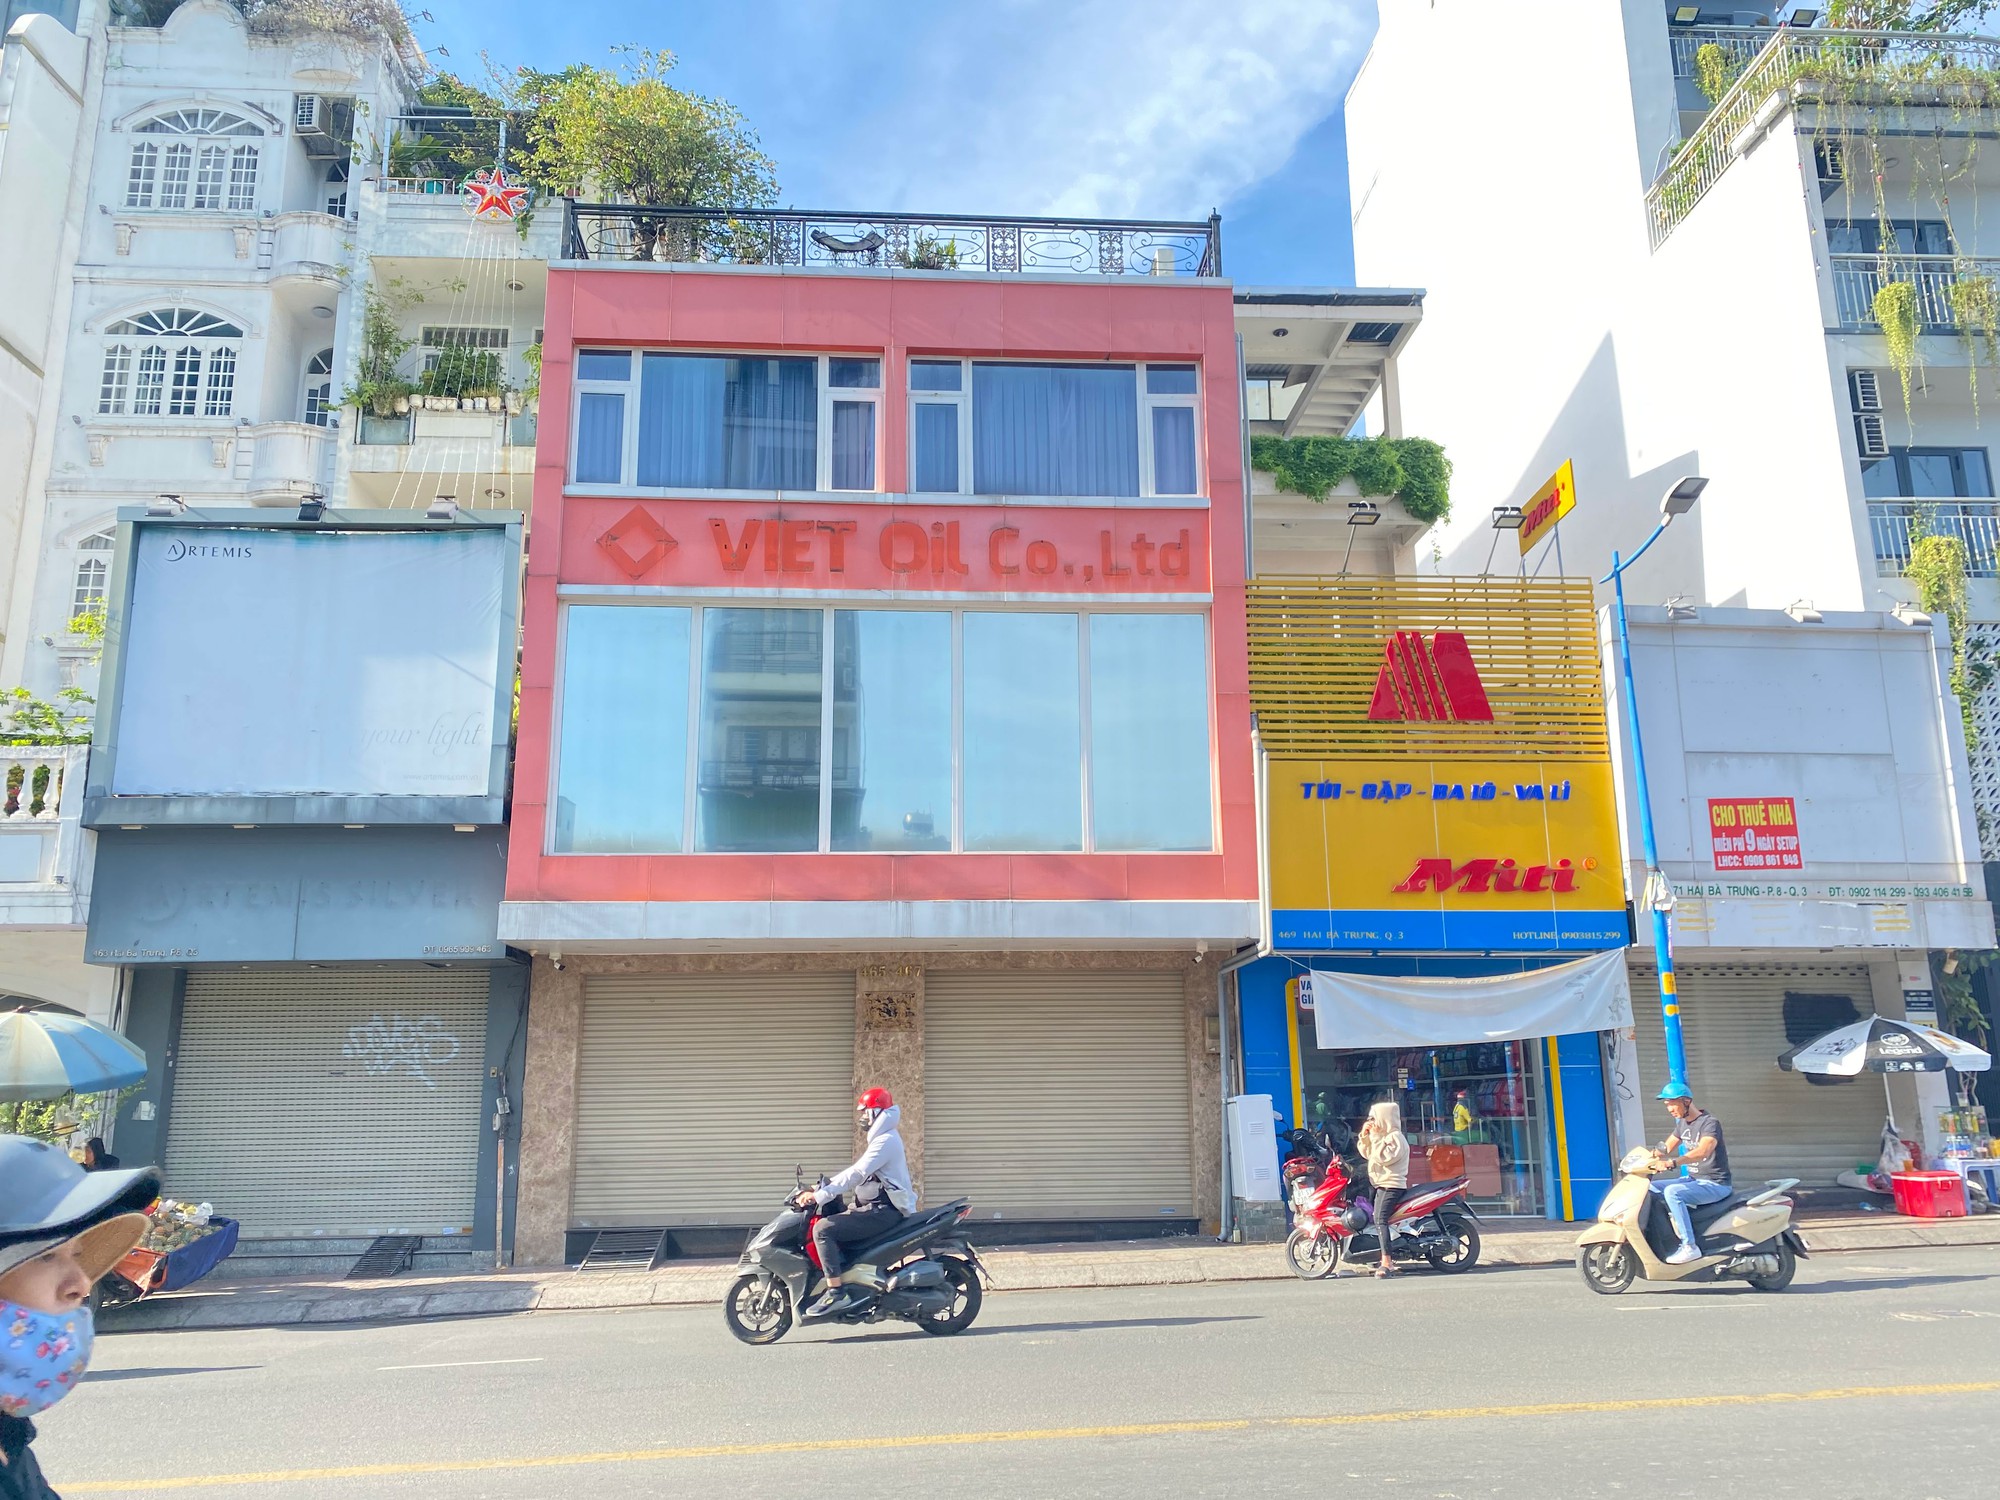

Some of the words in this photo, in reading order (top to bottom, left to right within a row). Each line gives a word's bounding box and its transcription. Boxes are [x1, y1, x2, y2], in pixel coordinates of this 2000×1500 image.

[164, 539, 252, 561] ARTEMIS
[708, 518, 858, 572] VIET
[879, 520, 968, 575] Oil
[427, 711, 485, 757] light
[1300, 779, 1341, 800] TÚI
[1432, 784, 1465, 800] BA
[1514, 784, 1545, 800] VA
[1712, 805, 1736, 827] CHO
[1737, 800, 1767, 826] THUÊ
[1768, 800, 1793, 826] NHÀ
[1745, 828, 1756, 852] 9
[1756, 833, 1775, 851] NGÀY
[1776, 836, 1798, 851] SETUP
[1718, 855, 1742, 867] LHCC:
[1391, 858, 1580, 893] Miti
[1673, 885, 1683, 896] 71
[1687, 886, 1704, 896] HAI
[1708, 884, 1722, 896] BÀ
[1849, 887, 1871, 897] 0902
[1874, 887, 1887, 897] 114
[1890, 887, 1906, 897] 299
[1914, 887, 1930, 897] 093
[1933, 887, 1949, 897] 406
[1278, 931, 1297, 939] 469
[1303, 931, 1322, 939] HAI
[861, 965, 886, 977] 465
[896, 965, 922, 977] 467
[1879, 1046, 1923, 1056] Legend
